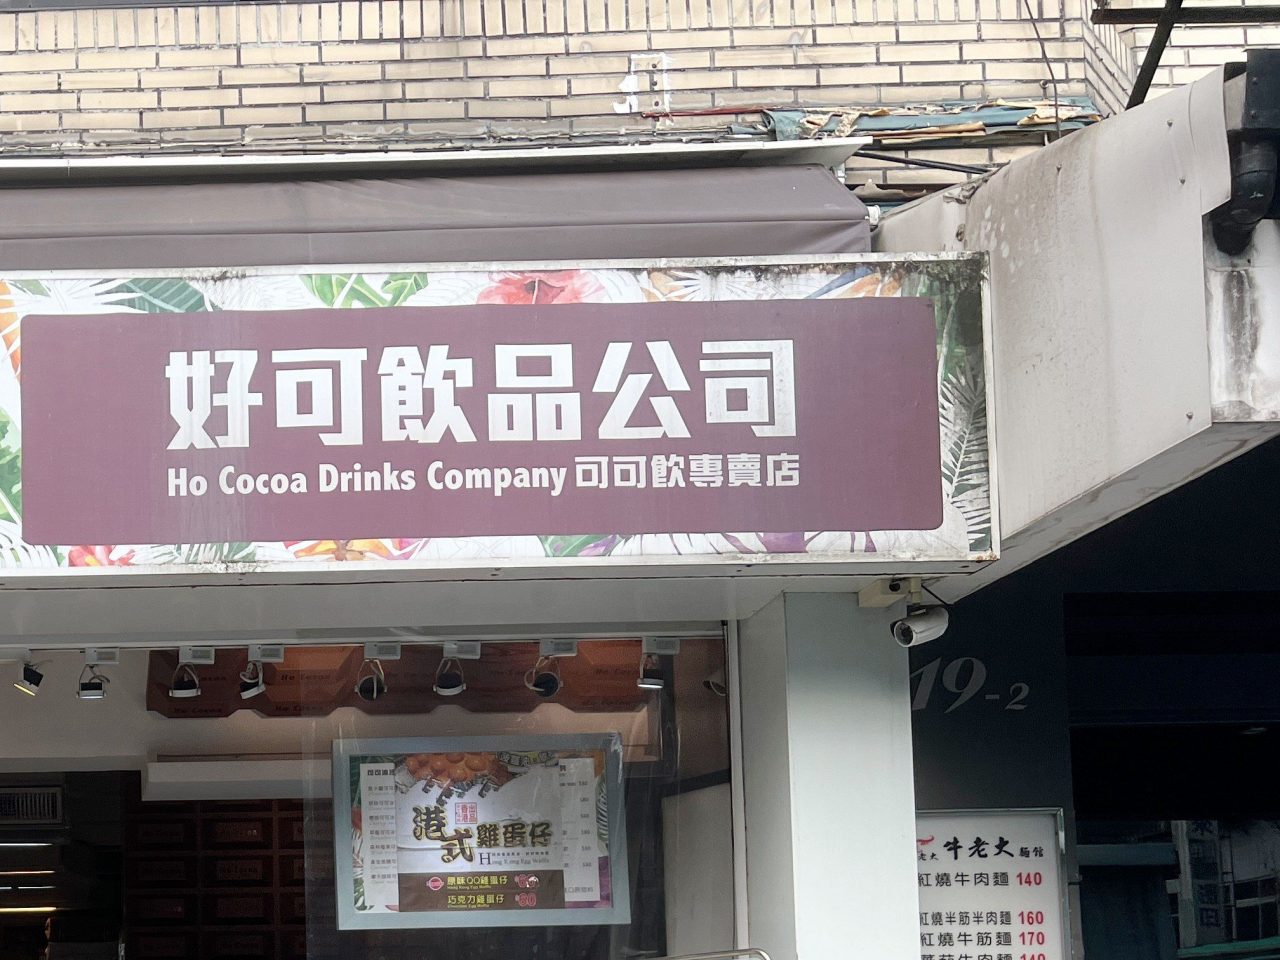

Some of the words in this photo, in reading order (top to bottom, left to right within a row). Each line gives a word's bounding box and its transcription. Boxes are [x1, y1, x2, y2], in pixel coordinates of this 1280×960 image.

[166, 339, 797, 450] 好可飲品公司
[167, 467, 207, 496] Ho
[218, 464, 308, 495] Cocoa
[320, 462, 416, 492] Drinks
[426, 460, 568, 497] Company
[575, 454, 800, 488] 可可飲專賣店
[413, 805, 552, 863] 港式雞蛋仔
[943, 836, 1015, 860] 牛老大
[918, 872, 1009, 887] 紅燒牛肉麵
[1016, 872, 1042, 886] 140
[447, 894, 504, 904] 巧克力雞蛋仔
[1018, 911, 1044, 925] 160
[921, 931, 1012, 946] 紅燒牛筋麵
[1019, 932, 1045, 945] 170
